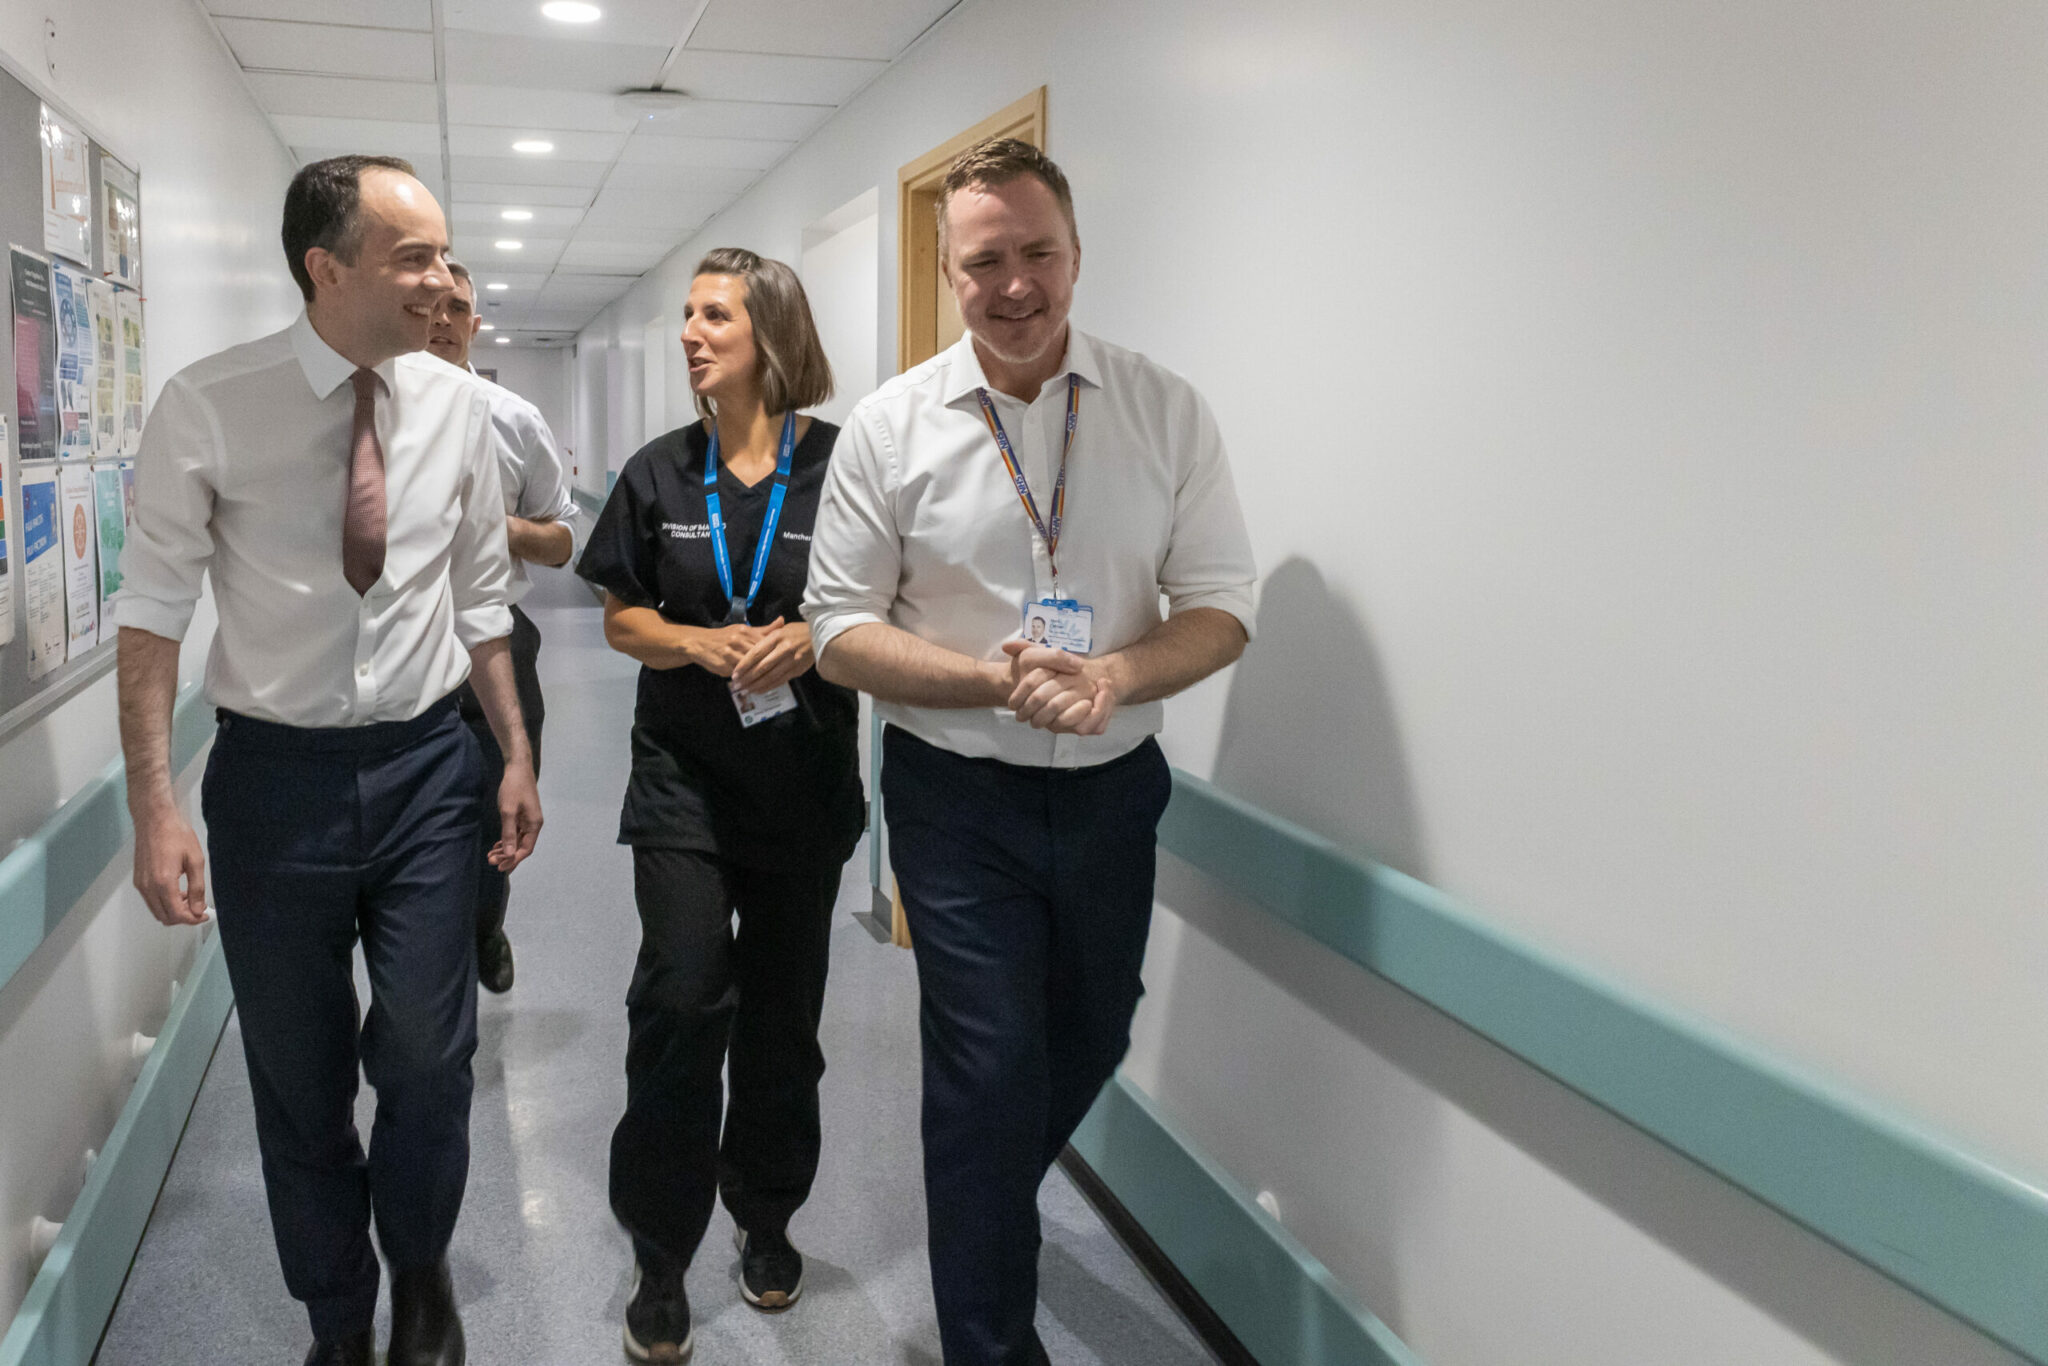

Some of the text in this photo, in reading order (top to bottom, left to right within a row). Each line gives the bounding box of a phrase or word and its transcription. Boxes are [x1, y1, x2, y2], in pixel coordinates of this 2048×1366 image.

[997, 431, 1009, 450] NHS
[1015, 474, 1027, 495] NHS
[670, 530, 711, 539] CONSULTAN
[688, 524, 698, 532] OF
